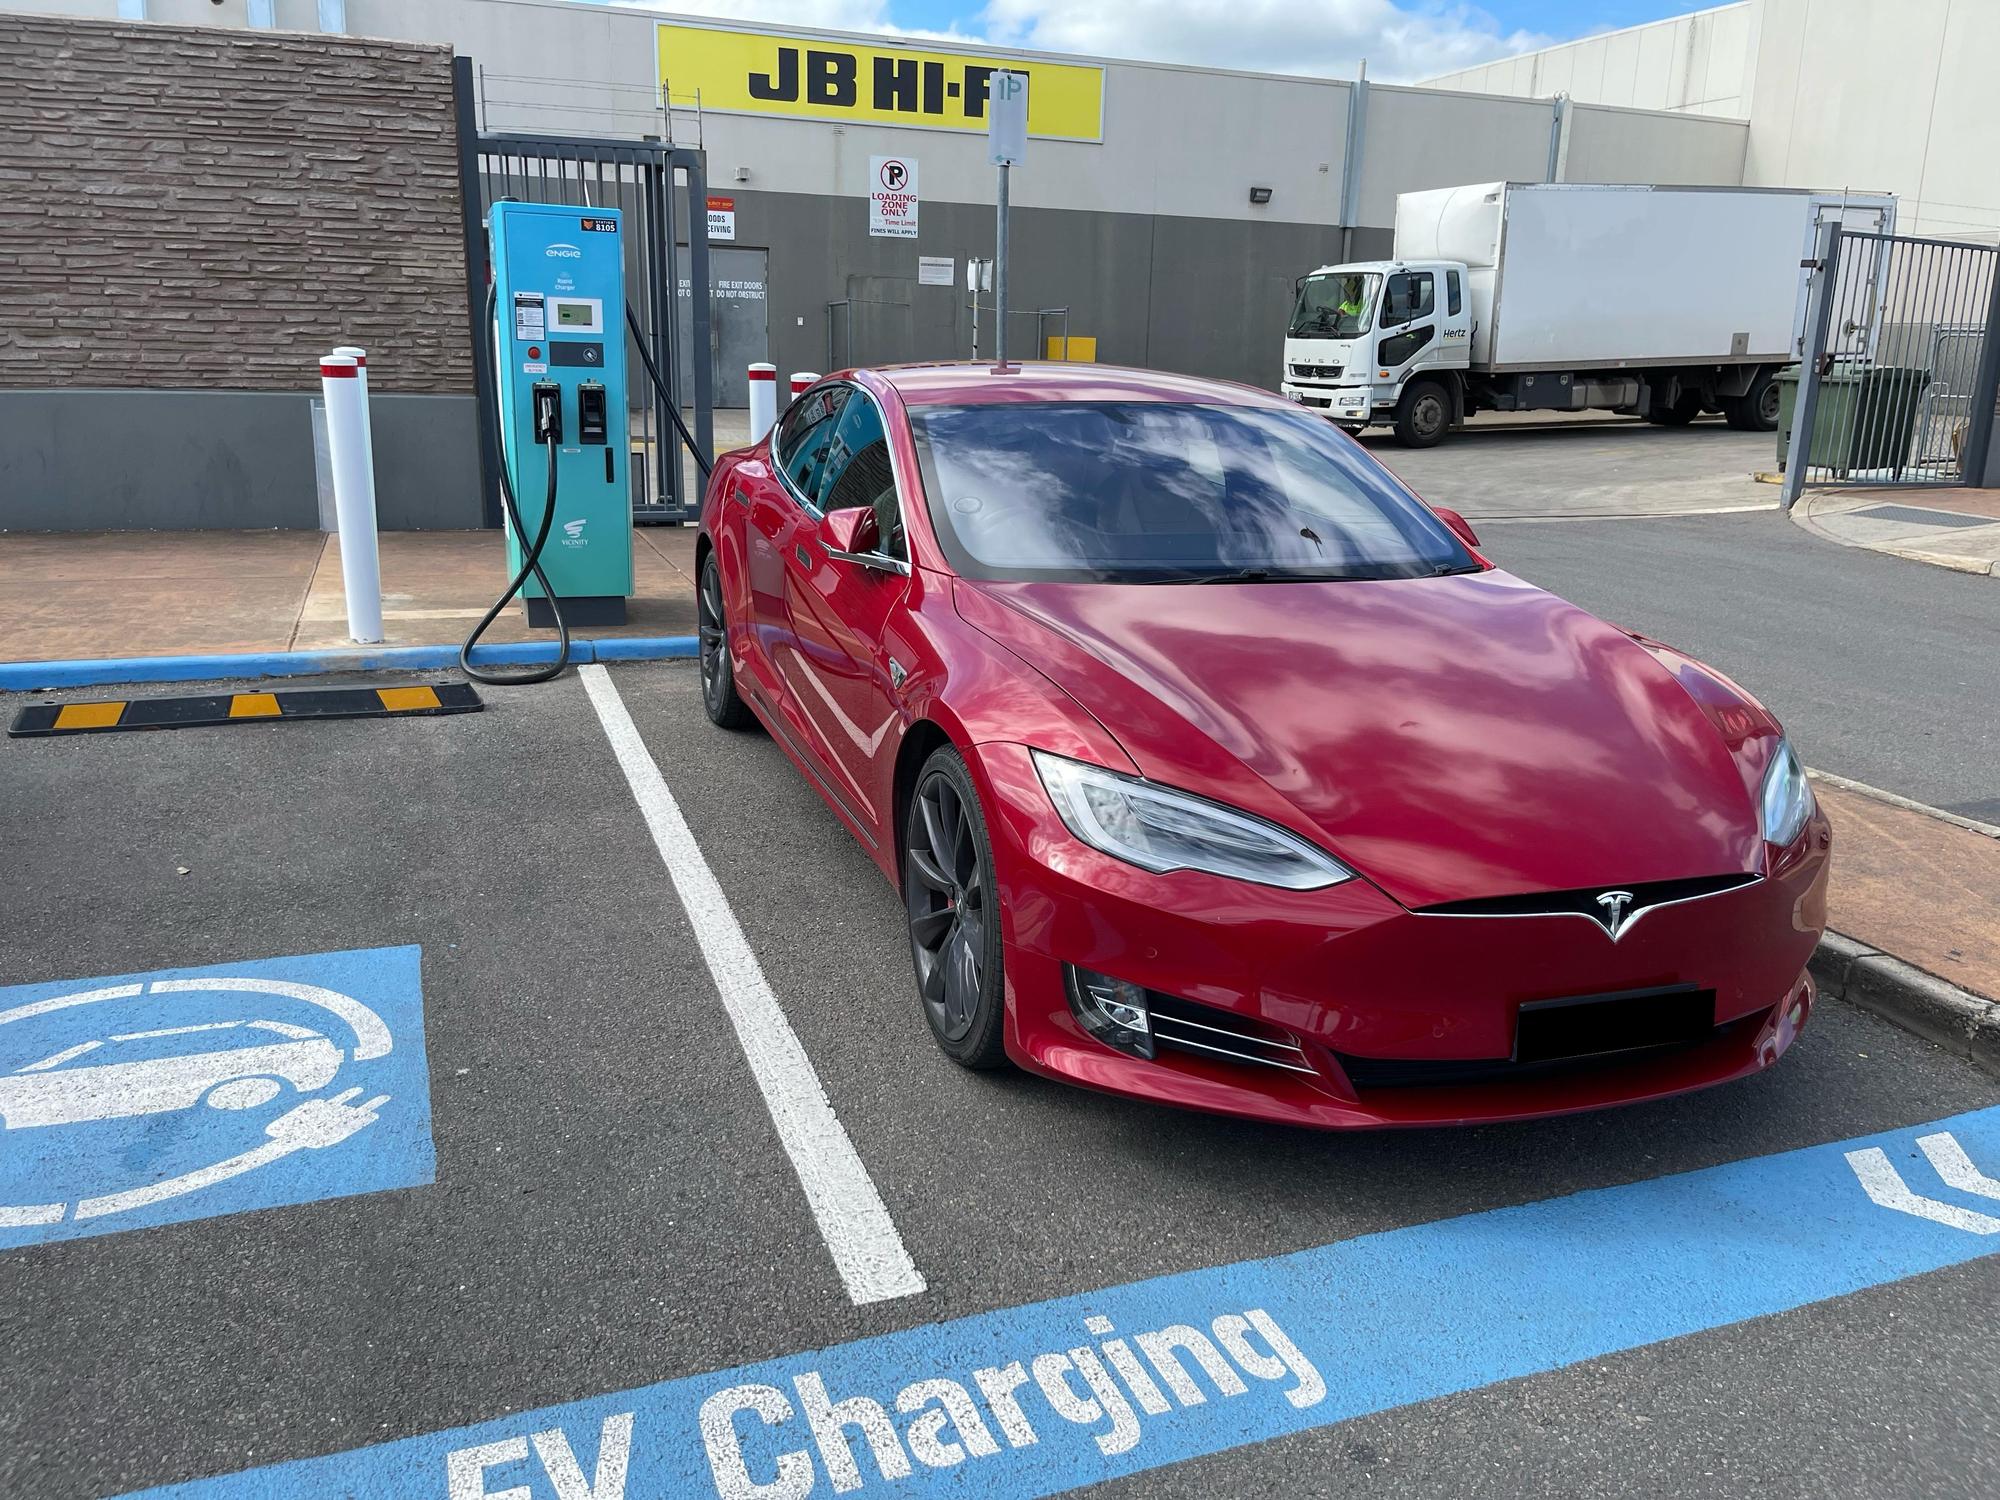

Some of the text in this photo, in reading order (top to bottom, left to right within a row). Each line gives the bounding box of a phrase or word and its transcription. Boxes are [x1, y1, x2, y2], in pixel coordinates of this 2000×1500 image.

[749, 47, 1030, 122] JB HI-F
[999, 78, 1022, 101] 1P
[871, 192, 917, 203] LOADING
[881, 201, 908, 209] ZONE
[881, 208, 908, 217] ONLY
[708, 214, 726, 223] OODS
[901, 219, 917, 227] Limit
[595, 223, 616, 232] 8105
[707, 225, 732, 234] CEIVING
[718, 280, 763, 290] FIRE EXIT DOORS
[716, 289, 725, 298] DO
[726, 290, 737, 298] NOT
[738, 290, 765, 299] OBSTRUCT
[1443, 328, 1467, 338] Hertz
[699, 1307, 1327, 1500] Charging
